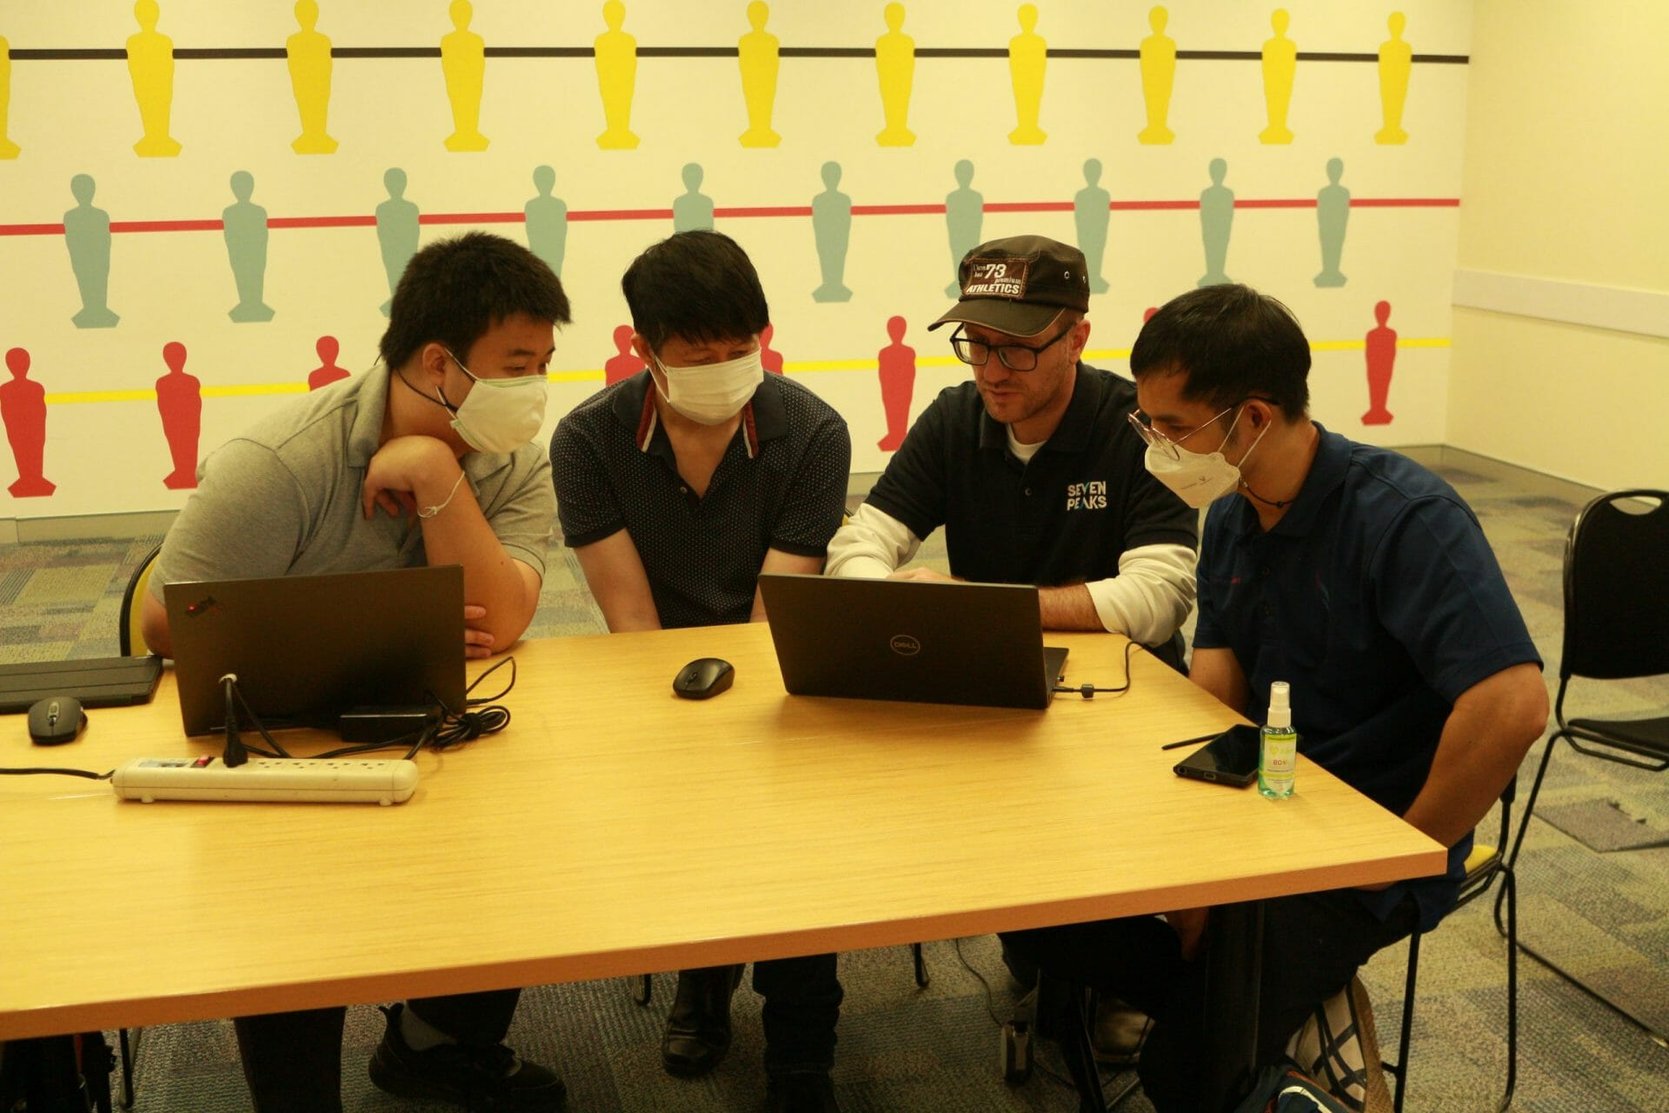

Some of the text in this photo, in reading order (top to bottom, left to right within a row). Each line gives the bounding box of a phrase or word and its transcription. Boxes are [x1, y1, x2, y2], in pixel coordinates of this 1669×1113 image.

[984, 263, 1007, 279] 73
[966, 283, 1020, 294] ATHLETICS
[1067, 480, 1107, 497] SEVEN
[1066, 495, 1108, 511] PEAKS
